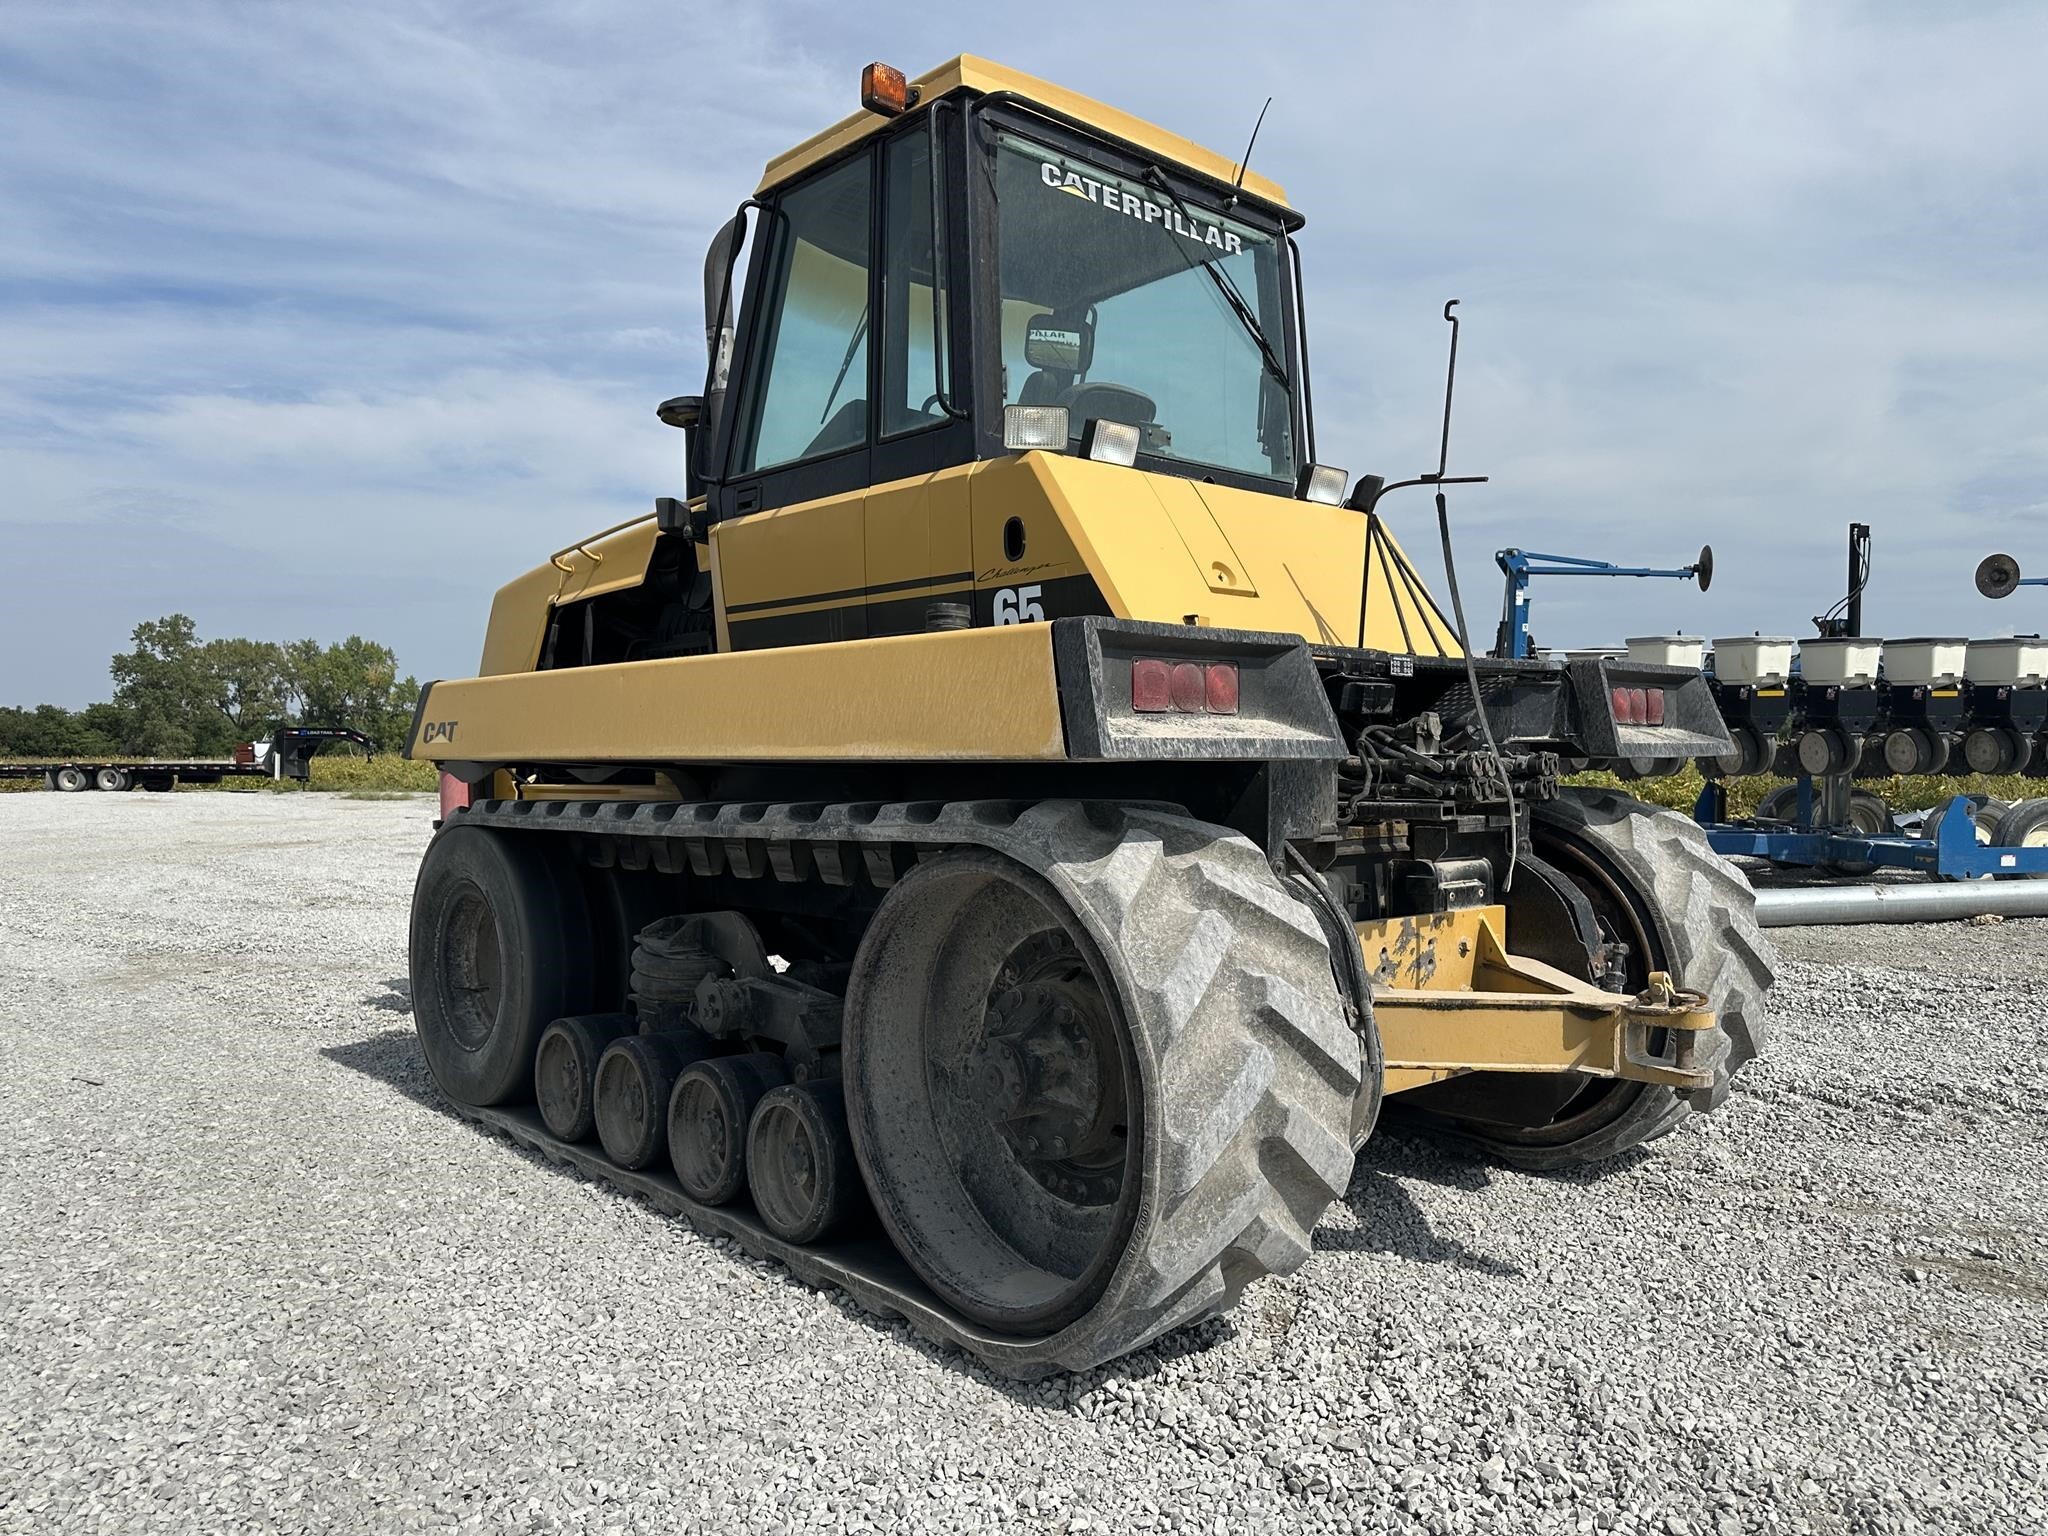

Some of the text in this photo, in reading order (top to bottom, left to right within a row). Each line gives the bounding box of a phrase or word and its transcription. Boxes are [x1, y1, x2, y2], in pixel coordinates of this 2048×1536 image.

[1040, 162, 1243, 256] CATERPILLAR
[976, 561, 1072, 583] Challenger
[993, 584, 1045, 627] 65
[423, 721, 459, 745] CAT
